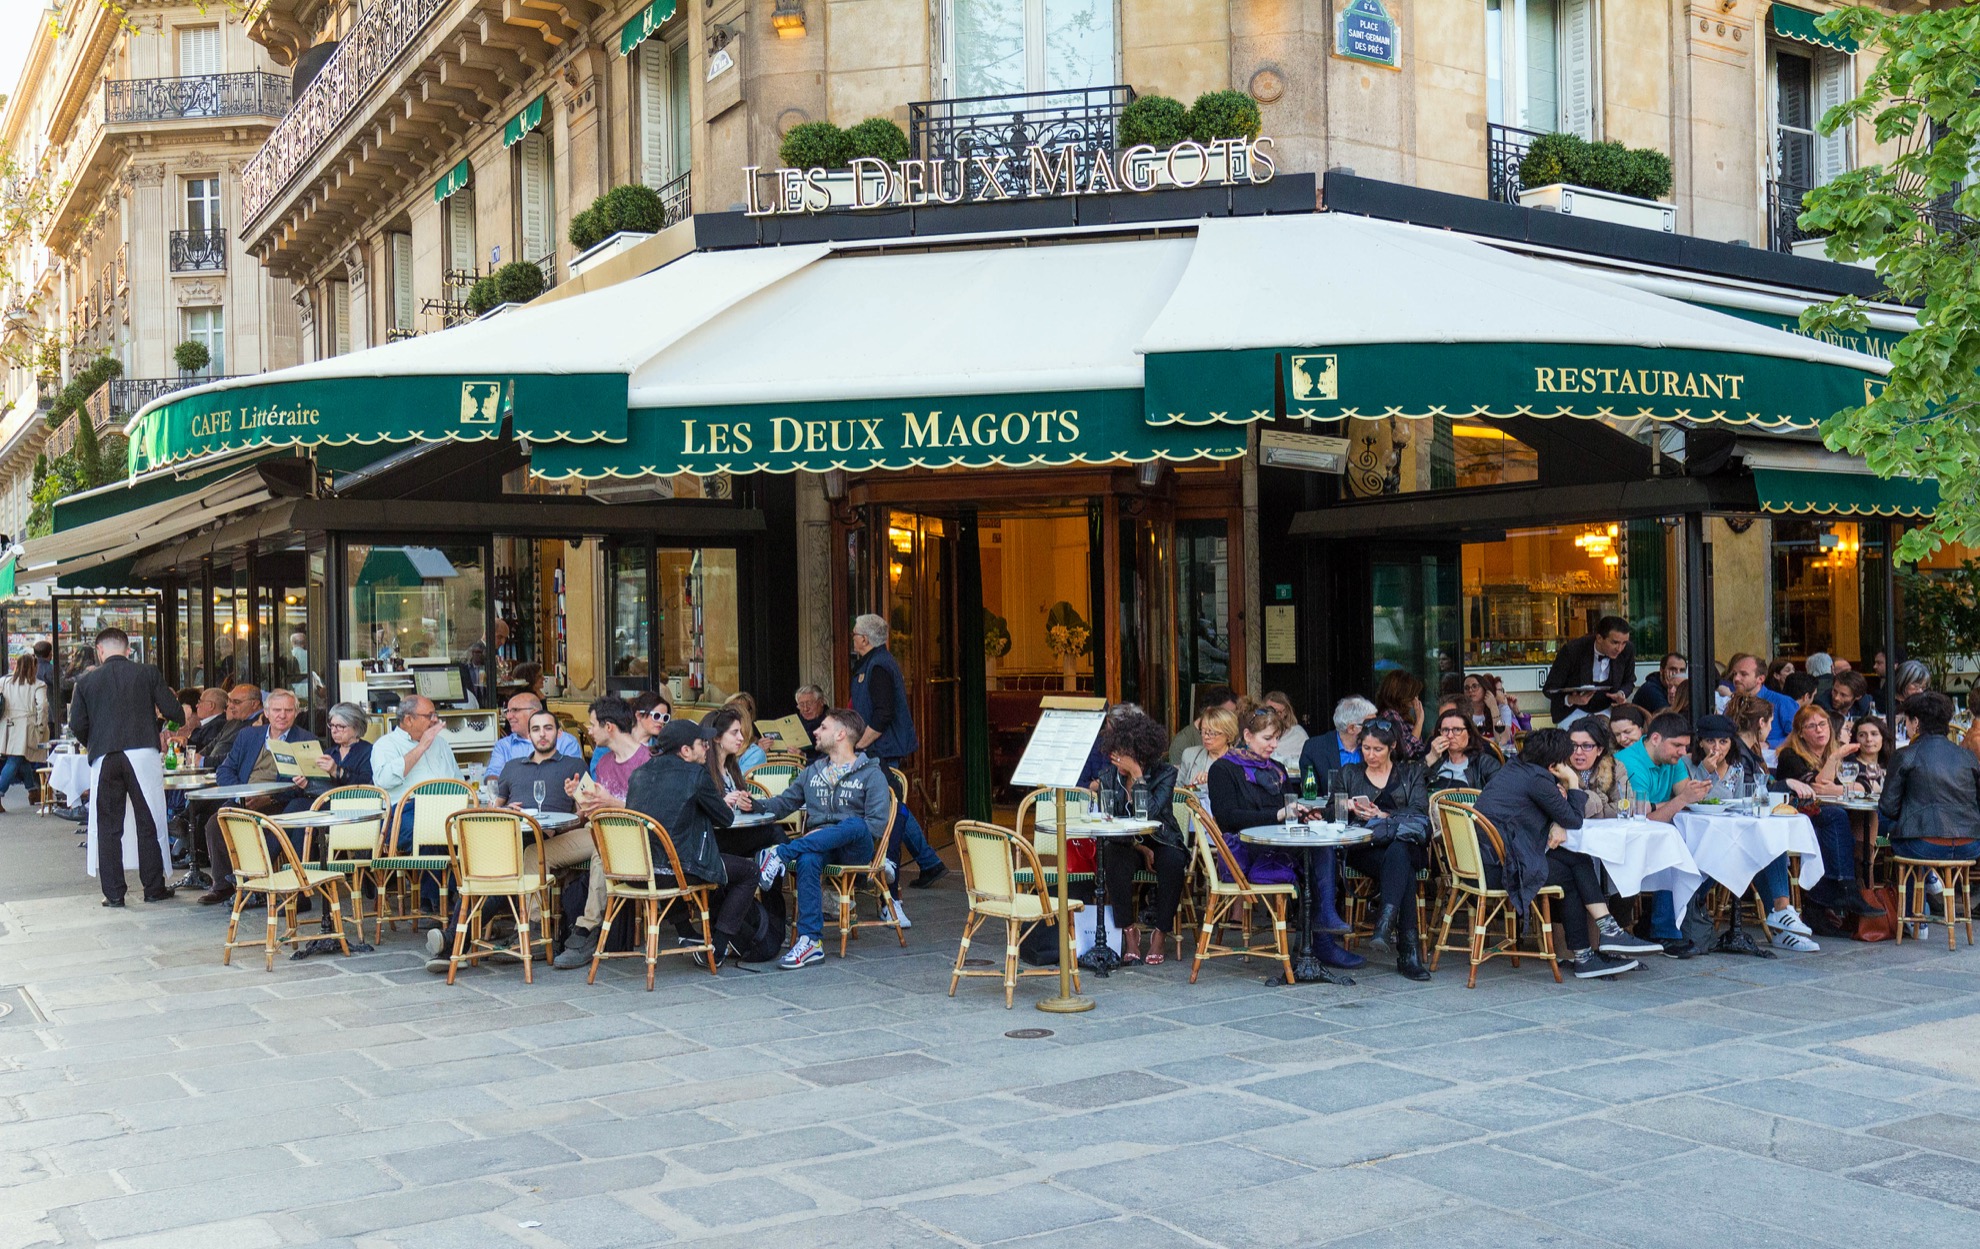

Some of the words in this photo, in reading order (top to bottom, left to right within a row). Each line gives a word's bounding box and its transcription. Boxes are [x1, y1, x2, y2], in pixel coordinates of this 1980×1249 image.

[1348, 29, 1390, 45] SAINT-GERMAIN
[1360, 20, 1379, 31] PLACE
[1354, 41, 1366, 51] DES
[742, 166, 832, 216] LES
[848, 155, 1011, 209] DEUX
[1026, 134, 1275, 197] MAGOTS
[1535, 367, 1744, 400] RESTAURANT
[191, 410, 232, 437] CAFE
[239, 402, 320, 430] Littéraire
[681, 418, 753, 455] LES
[769, 416, 885, 453] DEUX
[900, 409, 1080, 448] MAGOTS
